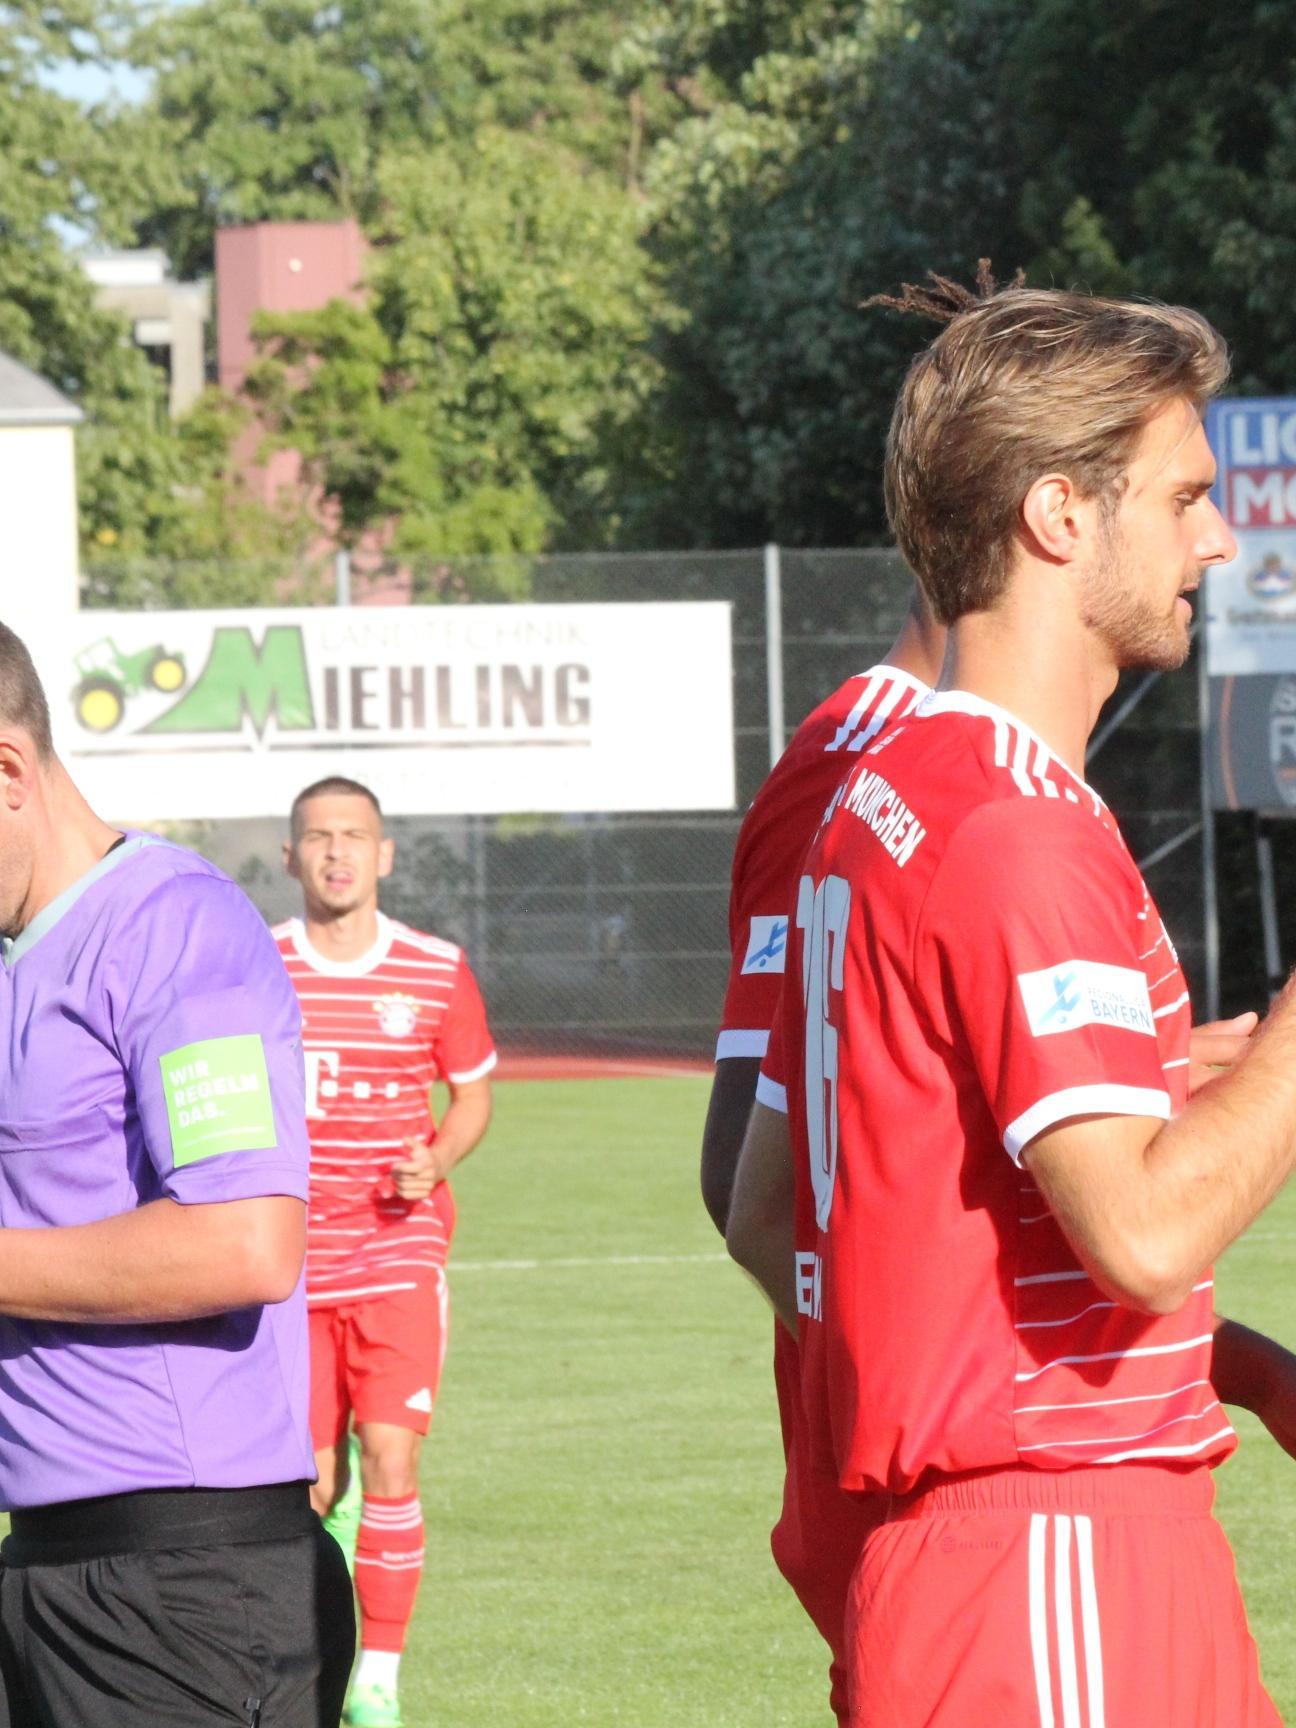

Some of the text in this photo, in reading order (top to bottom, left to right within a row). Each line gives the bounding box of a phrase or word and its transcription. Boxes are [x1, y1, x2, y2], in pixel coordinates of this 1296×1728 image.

[1090, 999, 1151, 1029] BAYERN
[168, 1060, 209, 1088] WIR
[173, 1072, 260, 1109] REGELN
